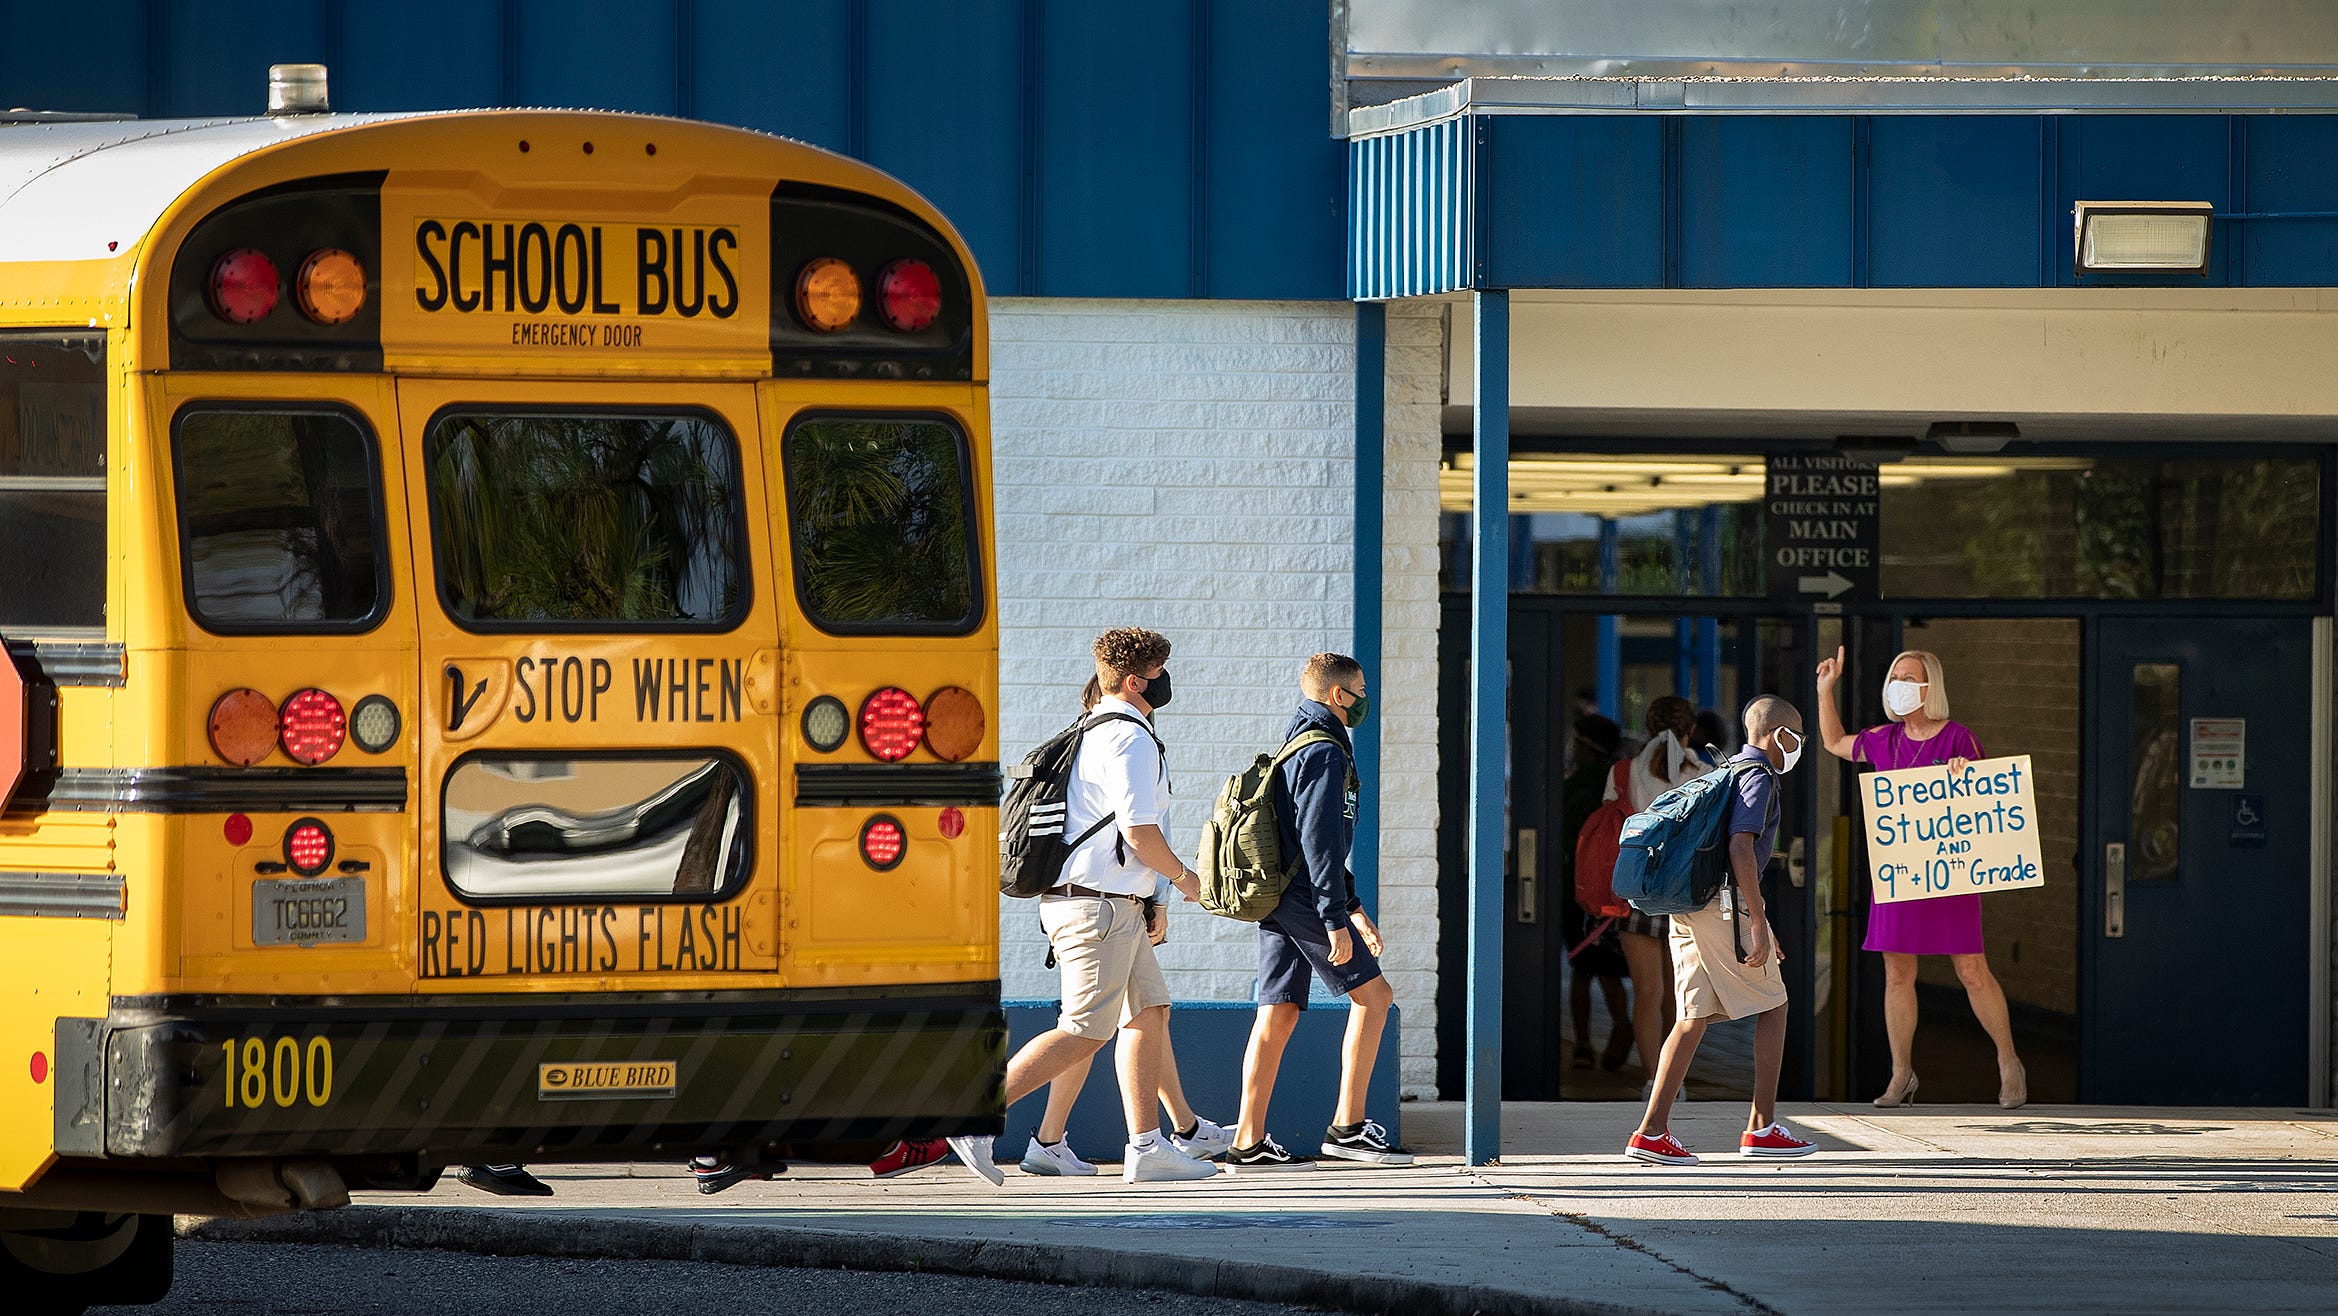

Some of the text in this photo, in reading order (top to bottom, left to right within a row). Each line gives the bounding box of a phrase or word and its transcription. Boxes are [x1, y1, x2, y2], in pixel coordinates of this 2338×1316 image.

[415, 219, 739, 319] SCHOOL BUS
[512, 322, 642, 347] EMERGENCY DOOR
[1770, 456, 1800, 470] ALL
[1771, 473, 1878, 496] PLEASE
[1771, 501, 1877, 516] CHECK IN AT
[1788, 520, 1859, 540] MAIN
[1775, 546, 1870, 568] OFFICE
[514, 656, 741, 723] STOP WHEN
[1873, 763, 2022, 808] Breakfast
[1875, 800, 2026, 846] Students
[1936, 840, 1972, 856] AND
[1970, 854, 2037, 886] Grade
[273, 898, 347, 930] TC6662
[422, 905, 740, 977] RED LIGHTS FLASH
[222, 1036, 332, 1108] 1800
[571, 1066, 670, 1088] BLUE BIRD
